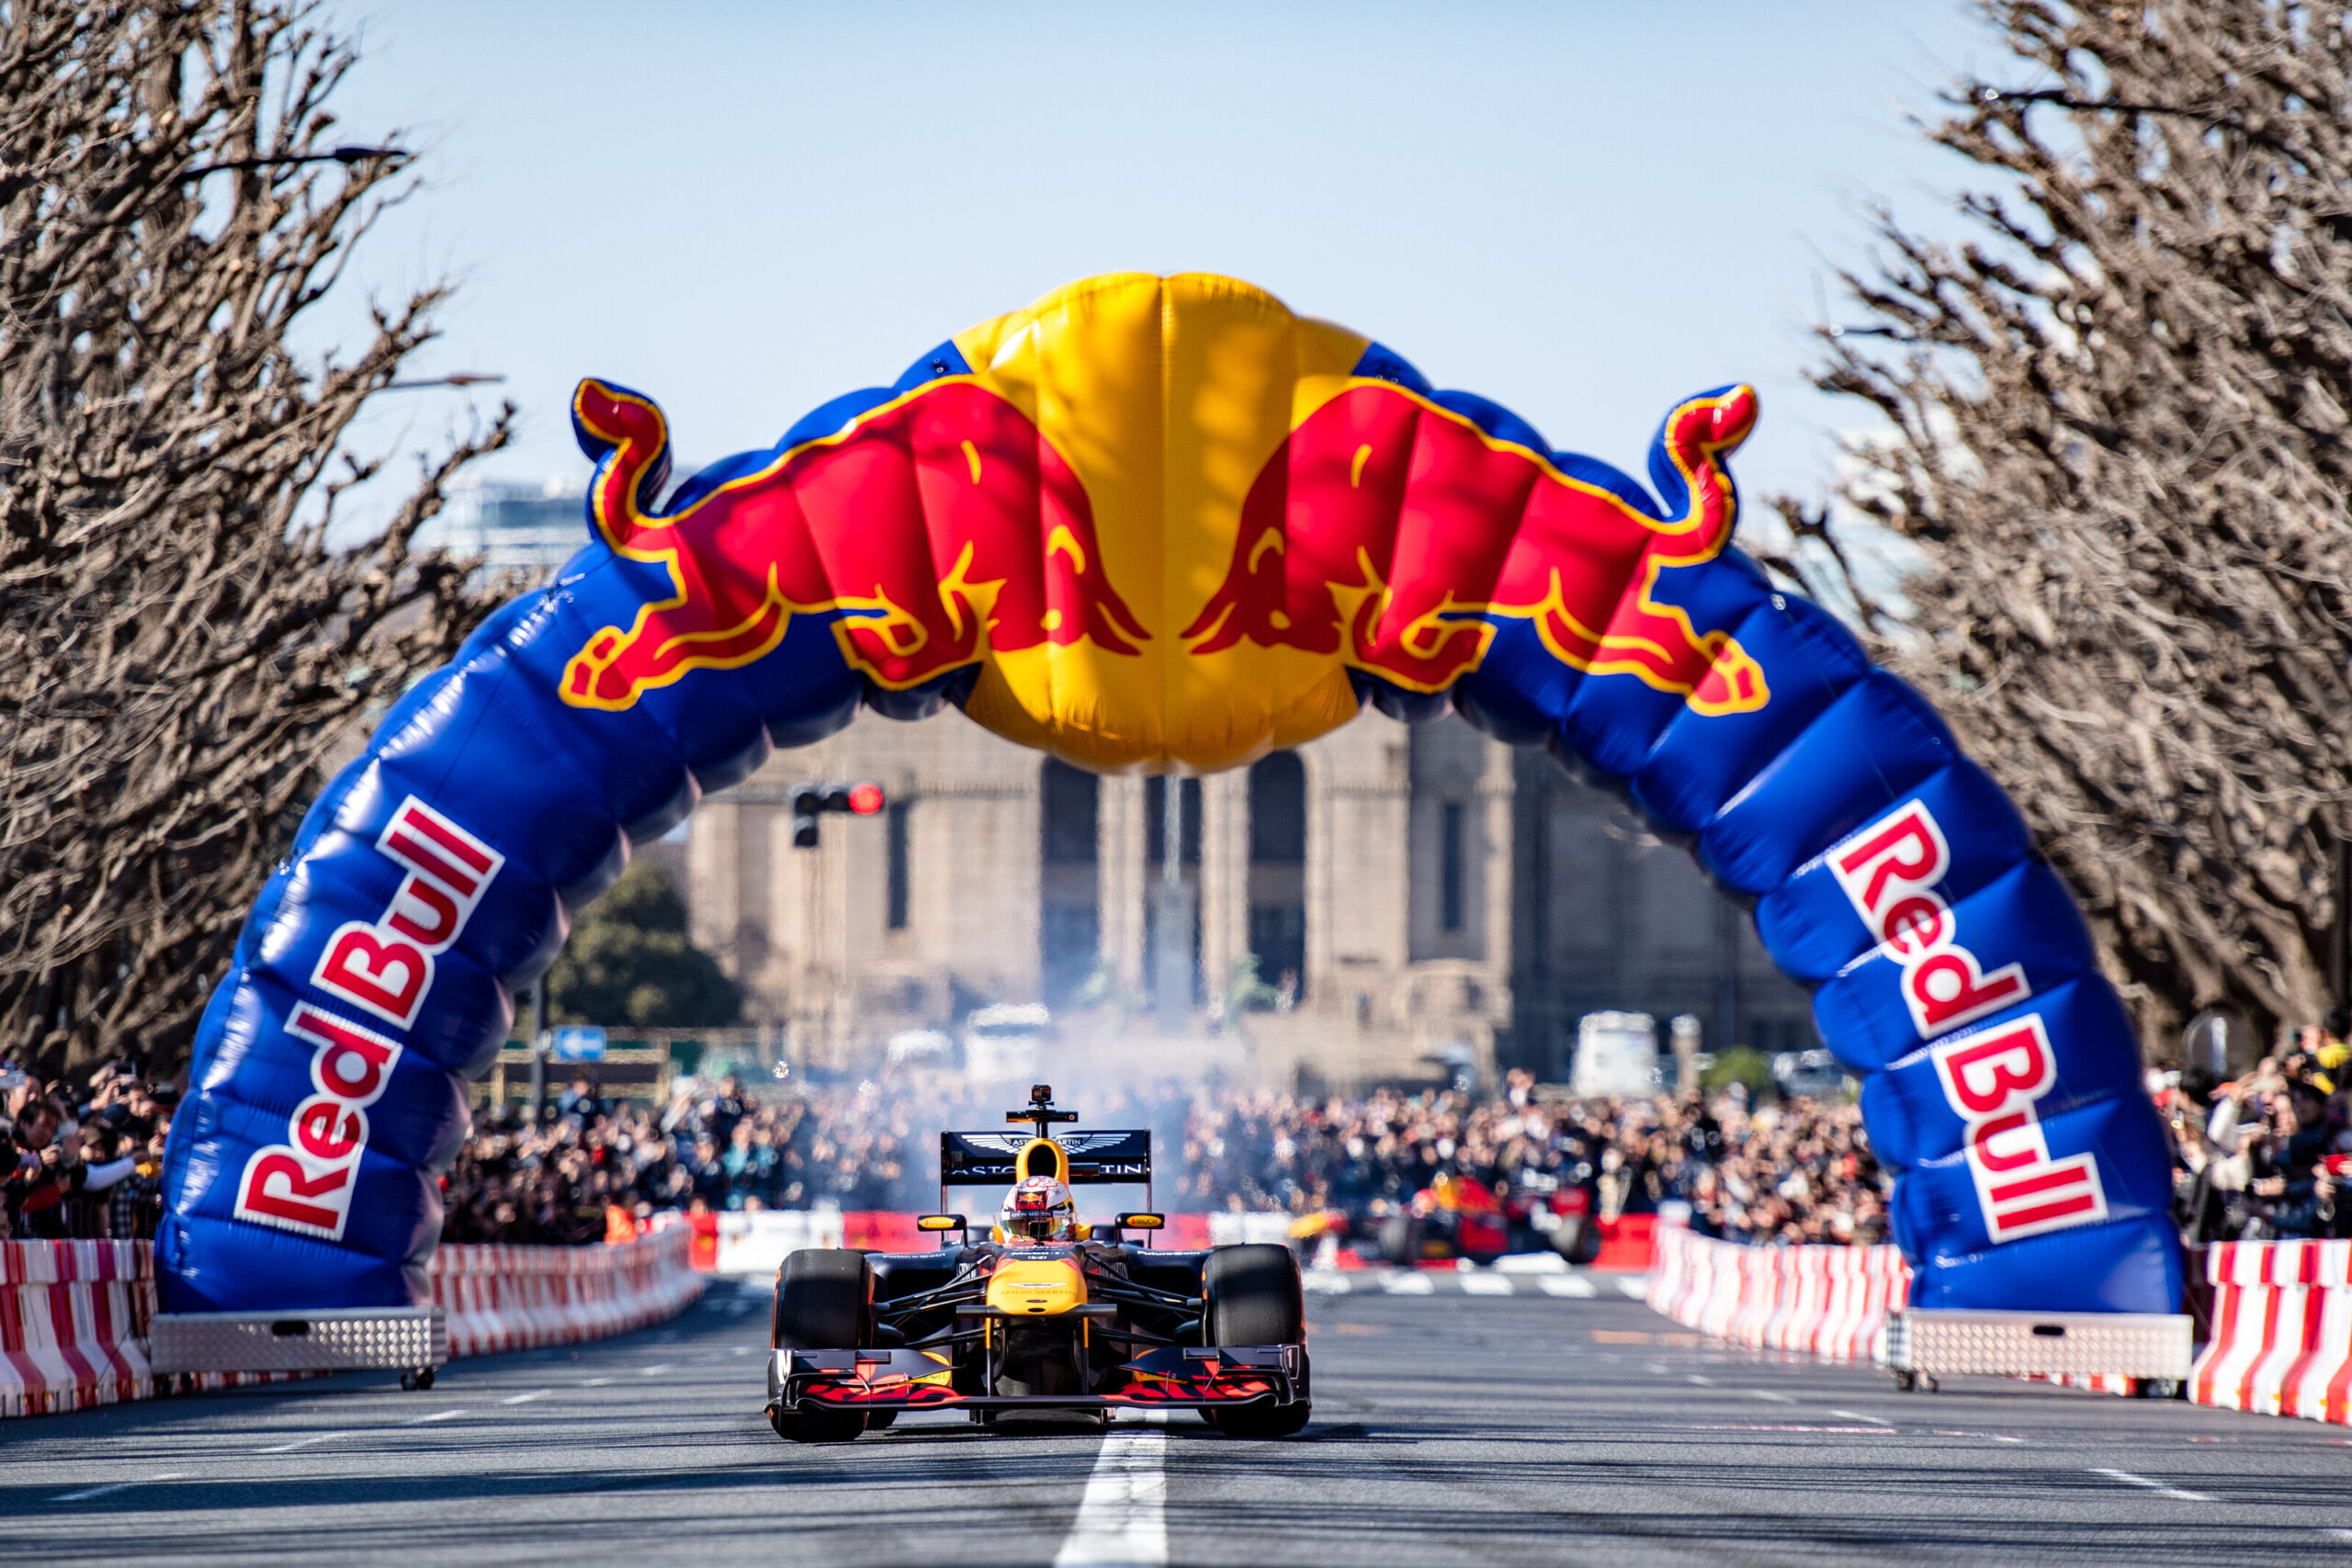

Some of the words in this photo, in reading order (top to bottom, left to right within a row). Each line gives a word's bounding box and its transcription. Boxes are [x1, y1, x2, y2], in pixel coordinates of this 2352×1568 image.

[316, 800, 501, 1025] Bull
[1832, 806, 2027, 1033] Red
[1939, 1019, 2101, 1235] Bull
[238, 1007, 397, 1235] Red
